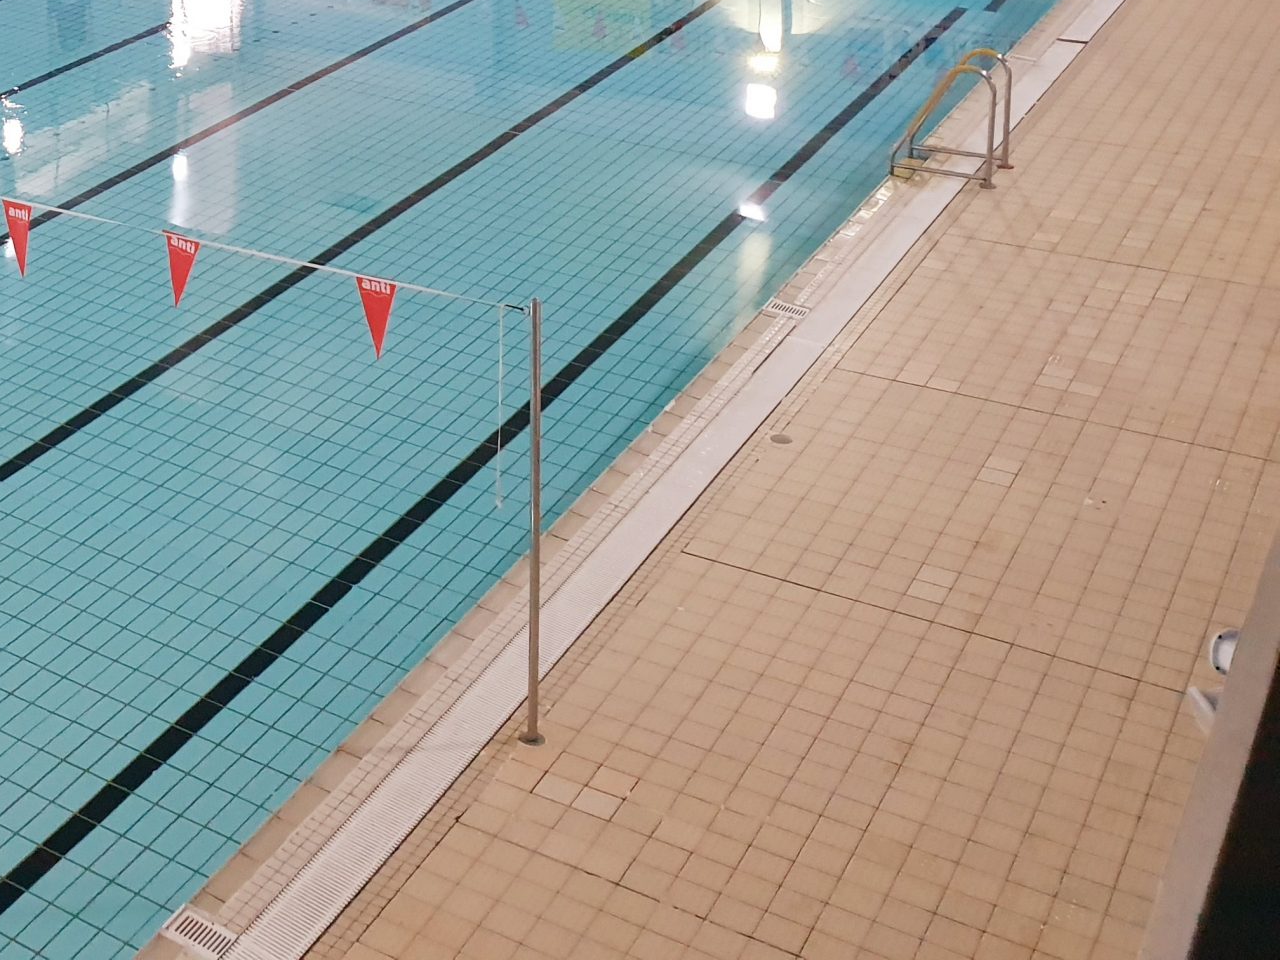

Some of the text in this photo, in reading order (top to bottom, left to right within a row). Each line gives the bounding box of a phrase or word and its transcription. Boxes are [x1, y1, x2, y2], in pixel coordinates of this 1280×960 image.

[8, 206, 29, 222] anti
[170, 235, 195, 254] anti
[361, 277, 390, 295] anti
